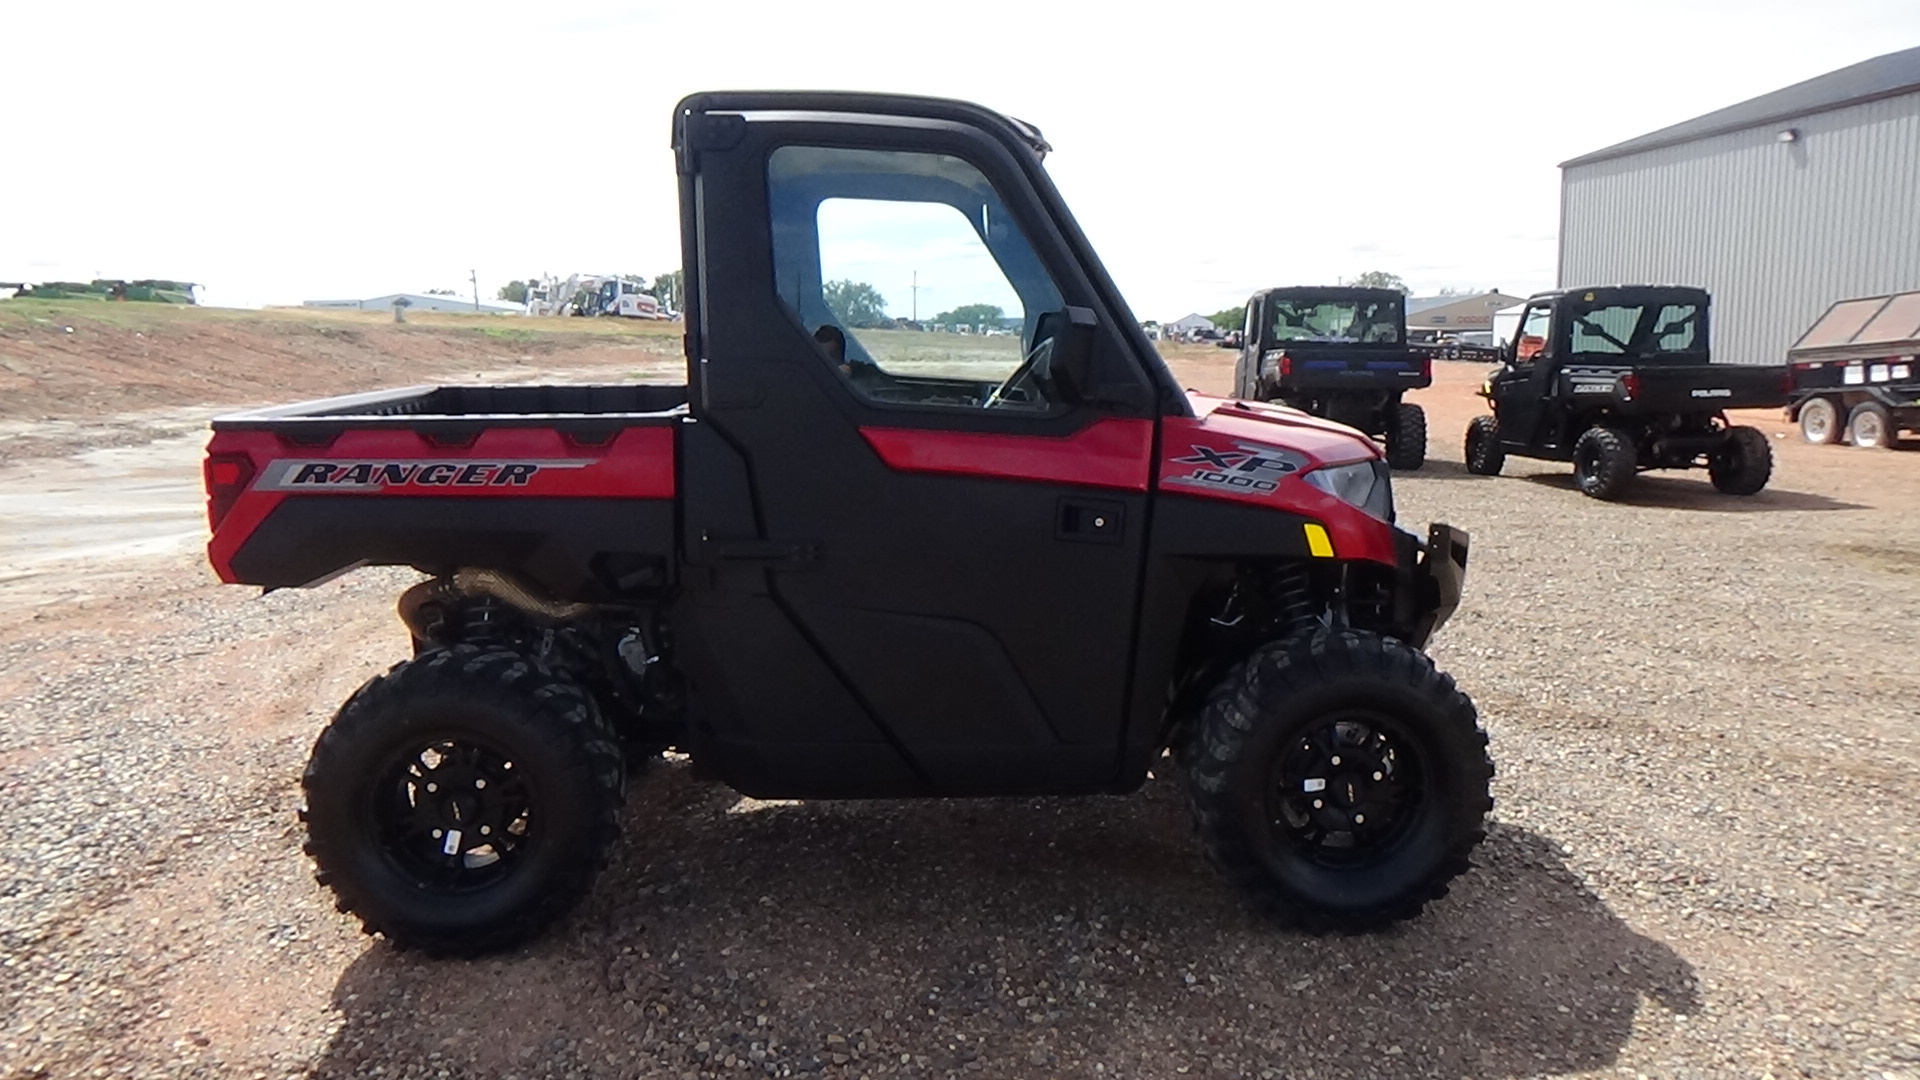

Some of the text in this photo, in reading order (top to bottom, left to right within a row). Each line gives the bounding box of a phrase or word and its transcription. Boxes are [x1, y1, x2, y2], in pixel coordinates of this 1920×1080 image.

[1170, 445, 1298, 473] XP
[291, 462, 539, 486] RANGER
[1193, 469, 1279, 492] 1000
